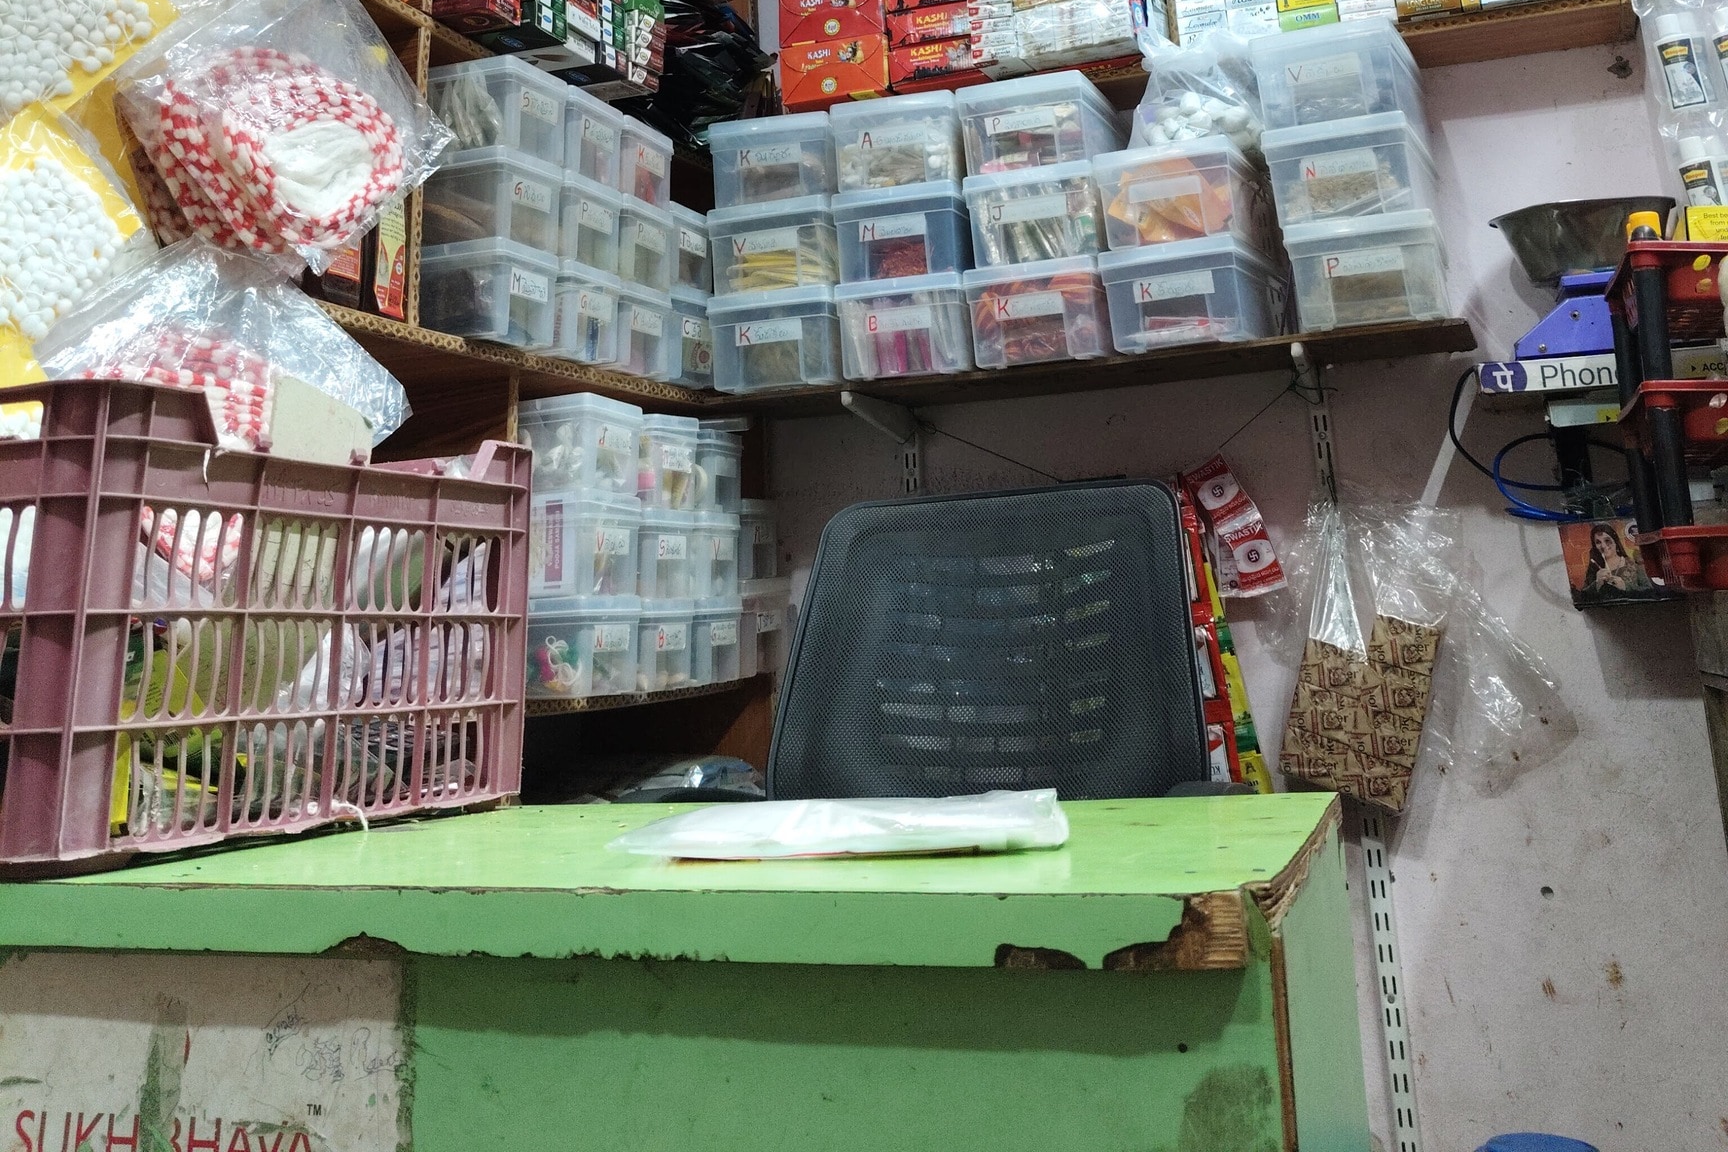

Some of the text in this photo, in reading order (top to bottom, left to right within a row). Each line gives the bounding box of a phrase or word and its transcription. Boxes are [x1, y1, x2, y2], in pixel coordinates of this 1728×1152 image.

[916, 12, 948, 24] KASHI
[1295, 12, 1320, 22] OMM
[807, 48, 831, 61] KASHI
[911, 44, 942, 57] KASHI
[1540, 361, 1617, 389] Phon
[1187, 458, 1224, 484] SWASTIK
[1224, 521, 1264, 544] SWASTIK
[307, 1104, 322, 1116] TM
[15, 1109, 313, 1152] SUKHBHAVA
